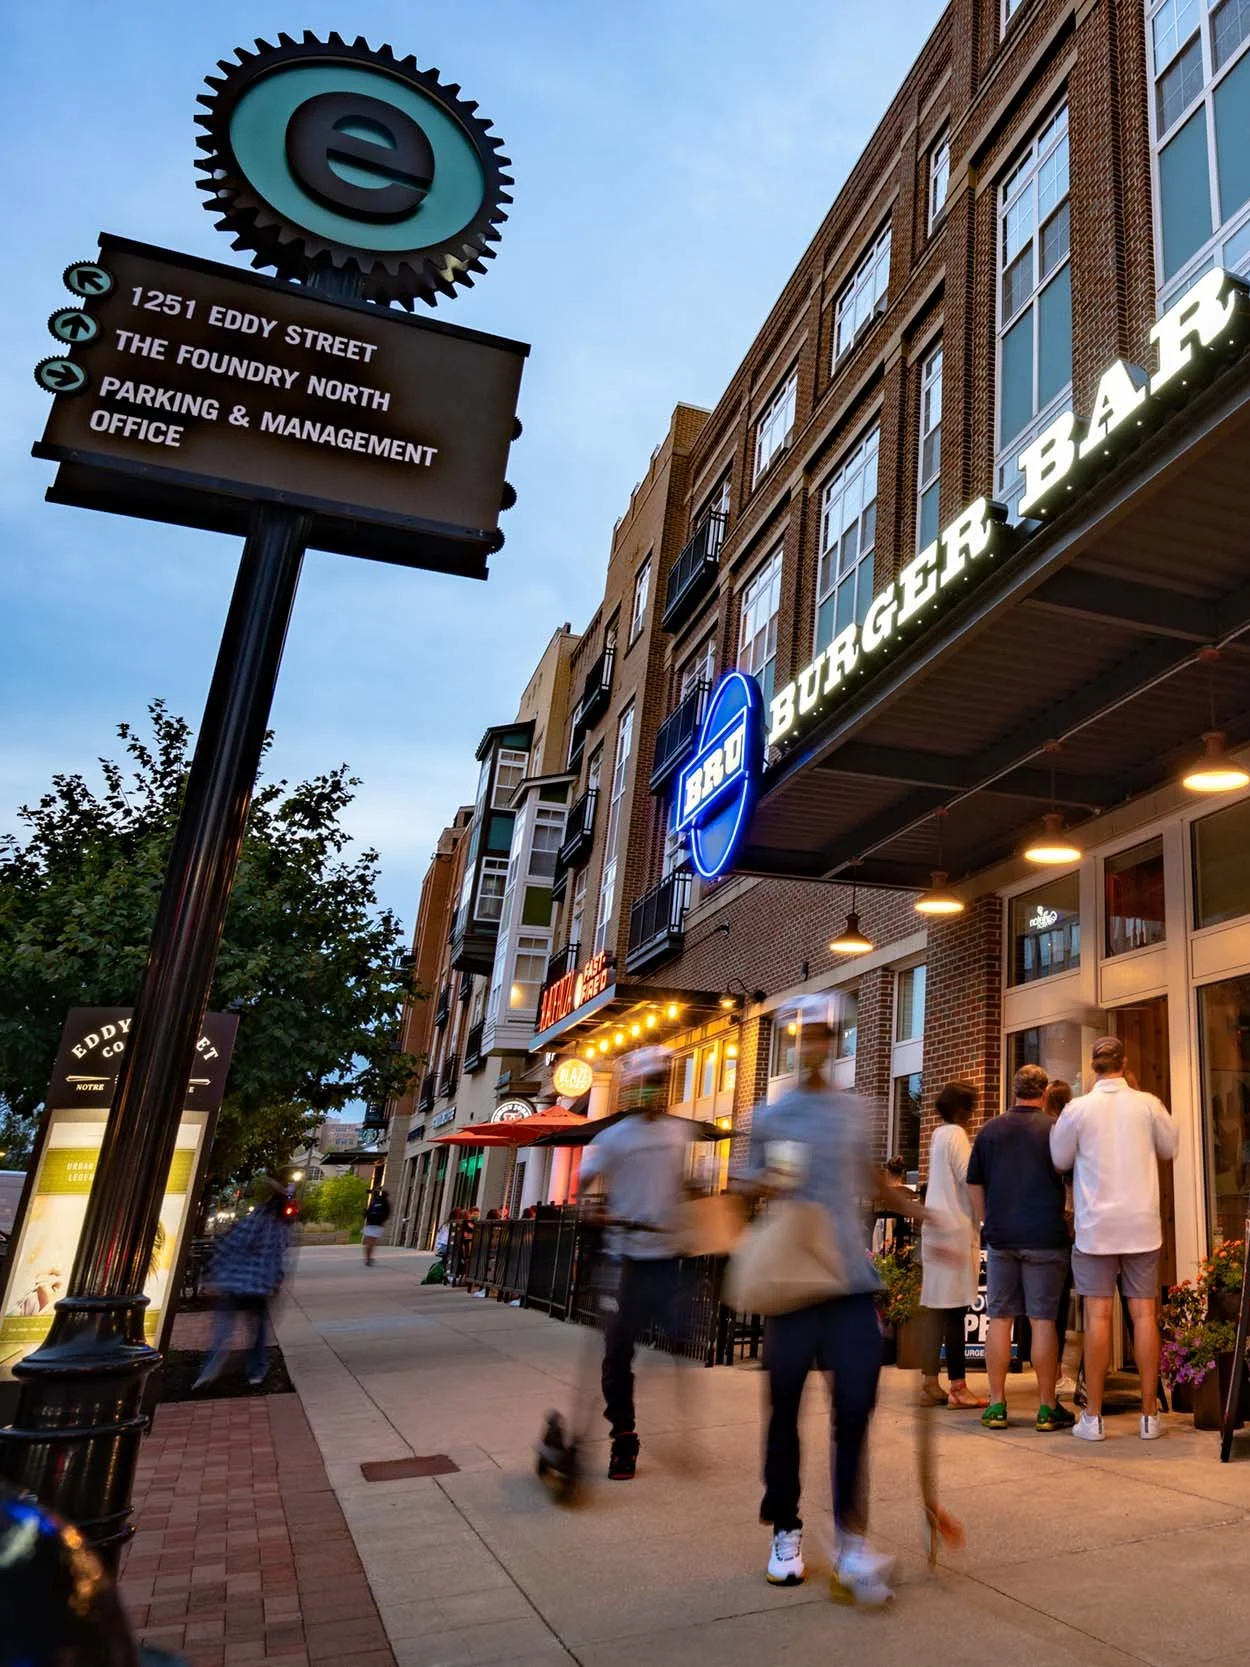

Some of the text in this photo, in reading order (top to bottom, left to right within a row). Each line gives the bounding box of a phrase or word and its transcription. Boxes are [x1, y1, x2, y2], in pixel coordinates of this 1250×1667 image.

[131, 286, 378, 363] 1251 EDDY STREET
[115, 330, 391, 412] THE FOUNDRY NORTH
[89, 409, 184, 448] OFFICE
[99, 376, 438, 468] PARKING & MANAGEMENT
[768, 266, 1238, 746] BURGER BAR
[683, 723, 745, 818] BRU
[71, 1018, 132, 1060] EDDY
[964, 1349, 985, 1357] URGE
